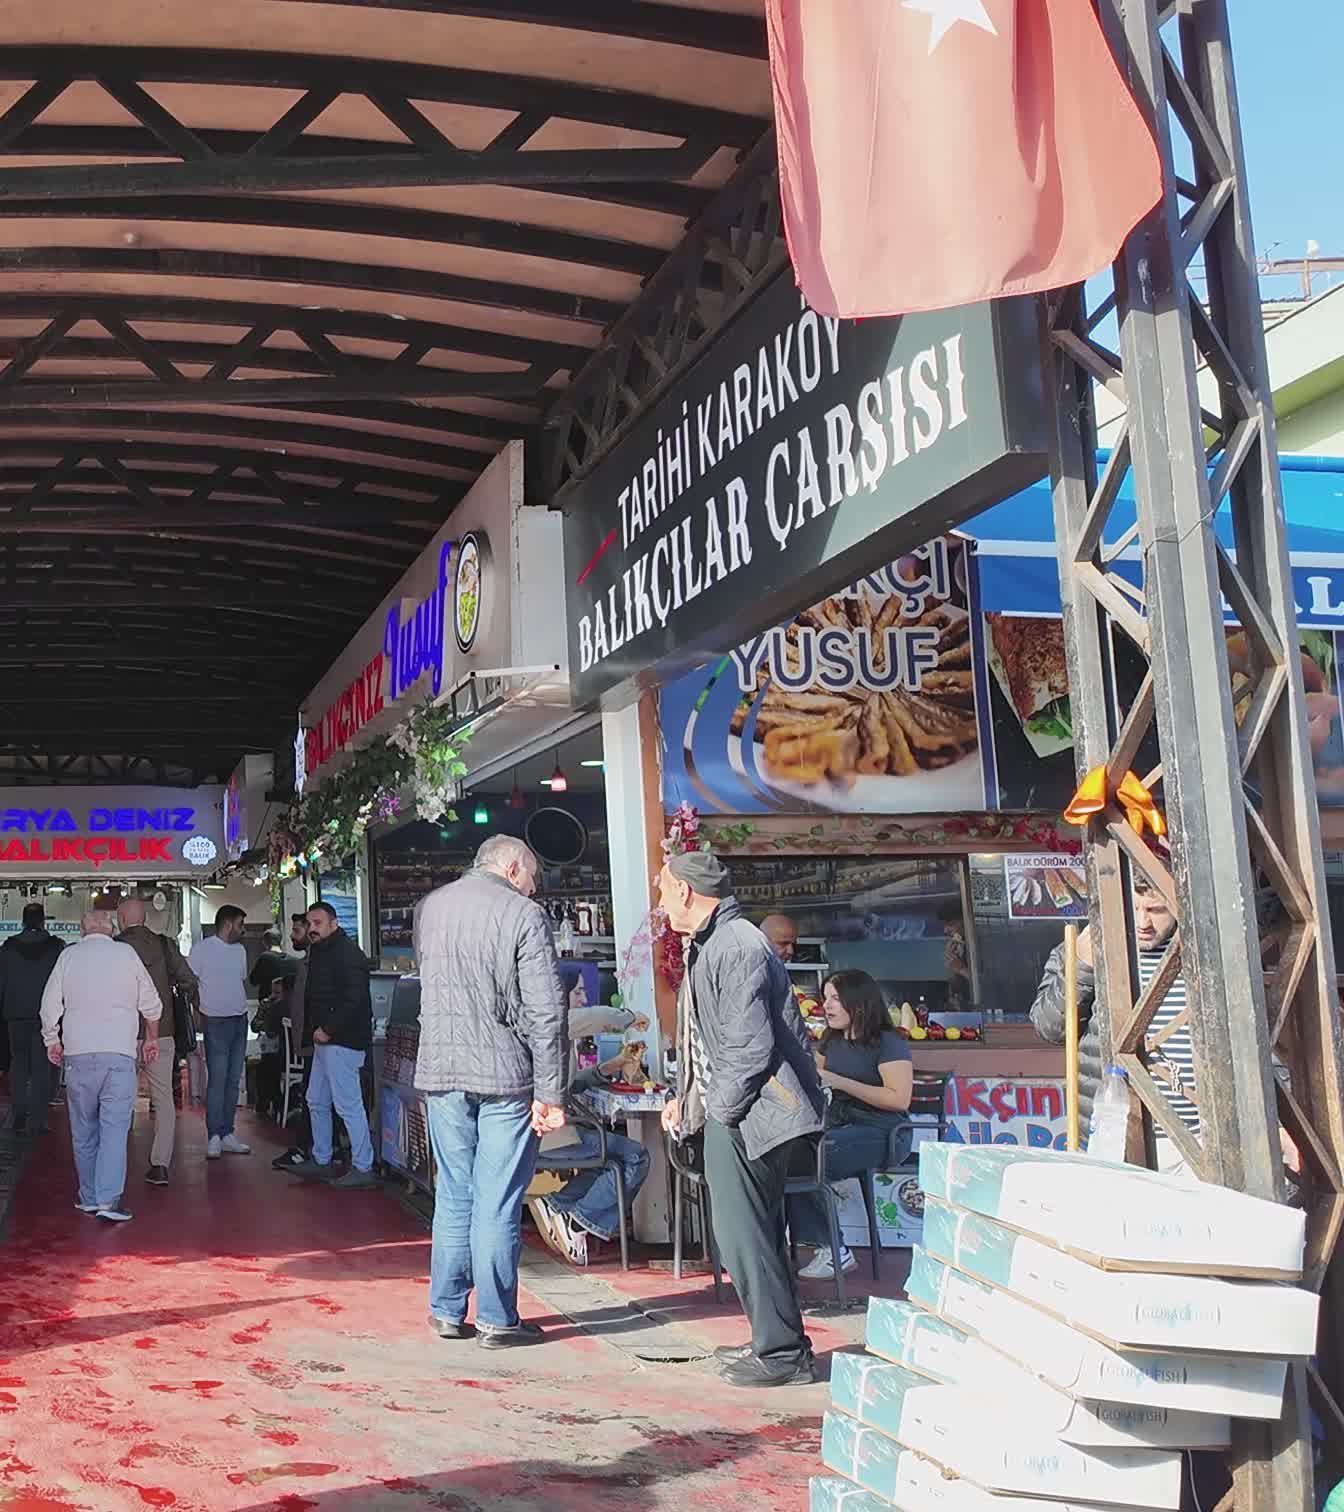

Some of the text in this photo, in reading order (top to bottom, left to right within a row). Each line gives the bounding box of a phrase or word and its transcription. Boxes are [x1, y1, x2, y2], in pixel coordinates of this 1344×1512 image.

[577, 333, 968, 673] BALIKÇILAR ÇARŞISI
[617, 293, 841, 552] TARİHİ KARAKÖY
[734, 628, 943, 693] YUSUF
